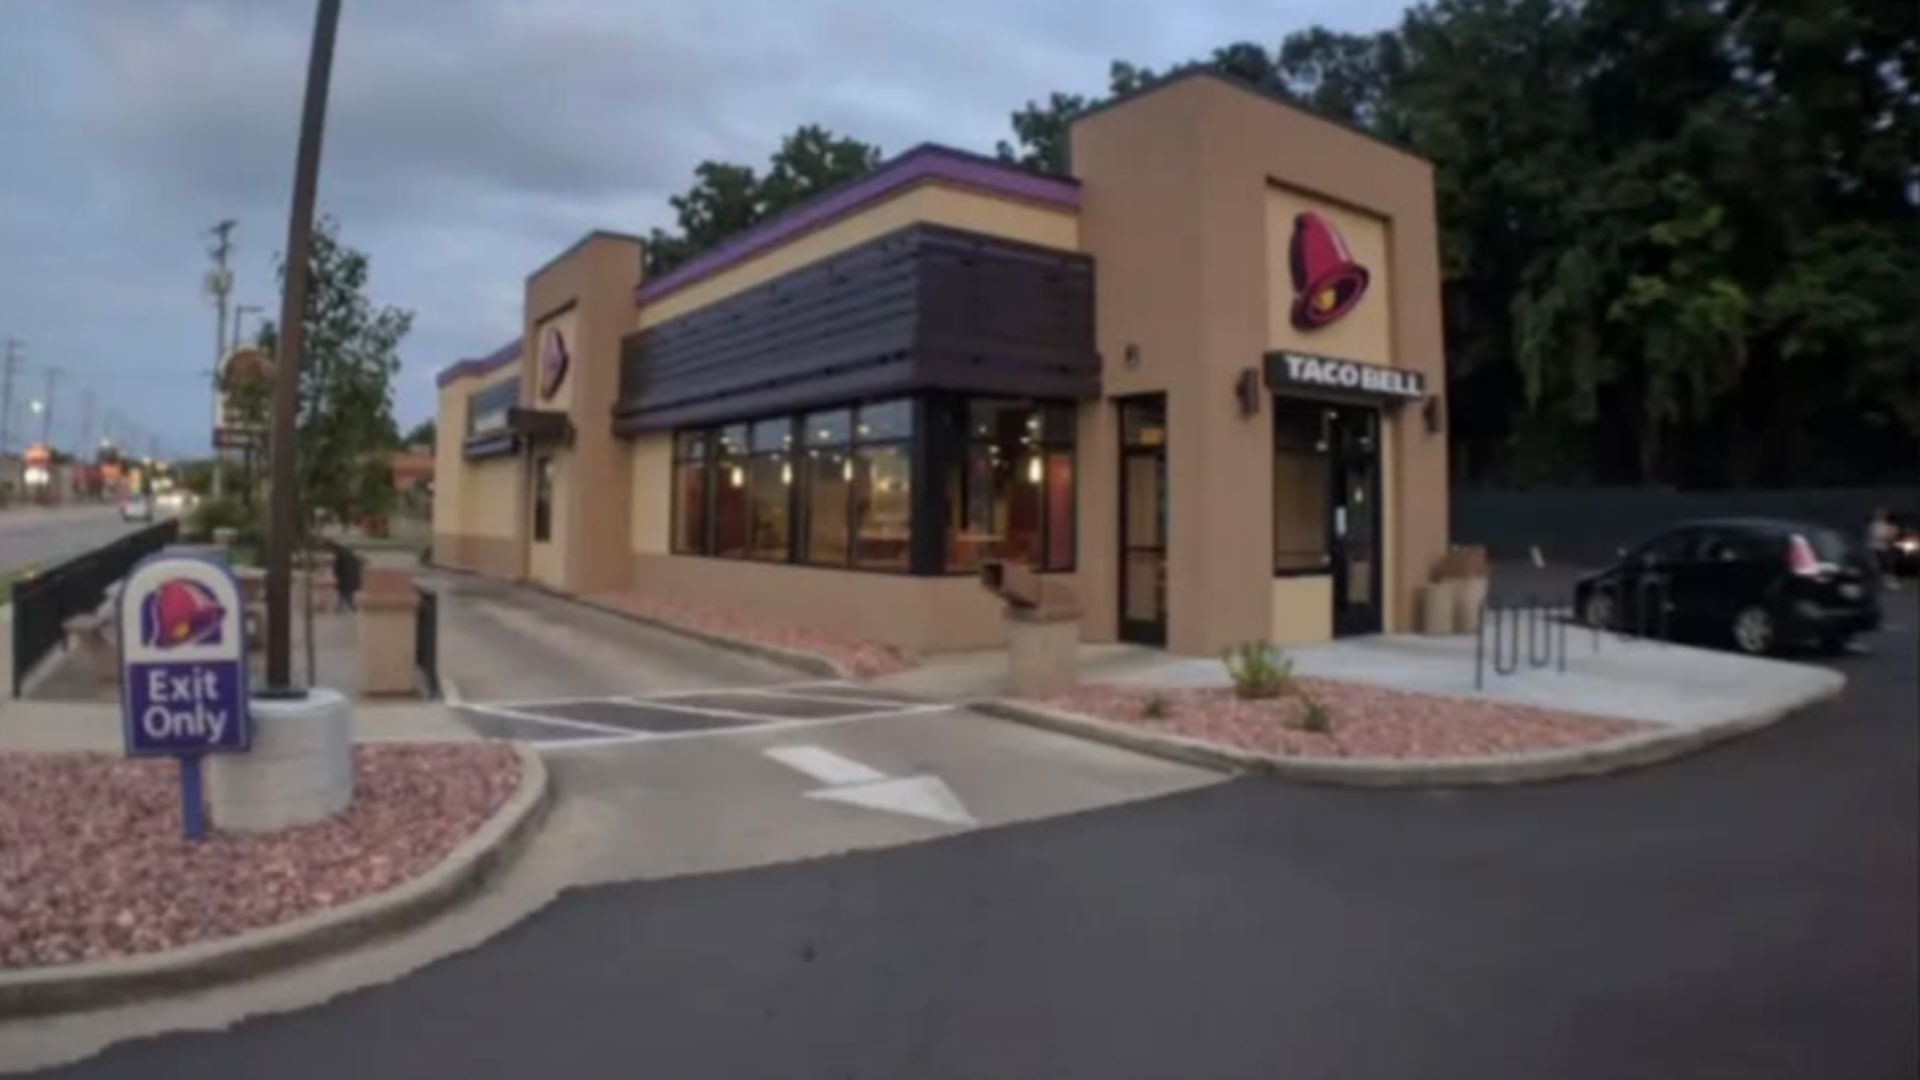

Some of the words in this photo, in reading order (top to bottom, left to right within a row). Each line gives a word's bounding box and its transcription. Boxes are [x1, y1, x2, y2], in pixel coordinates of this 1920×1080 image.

[1284, 354, 1359, 387] TACO
[1361, 366, 1422, 396] BELL
[148, 667, 219, 702] Exit
[143, 702, 228, 744] Only
